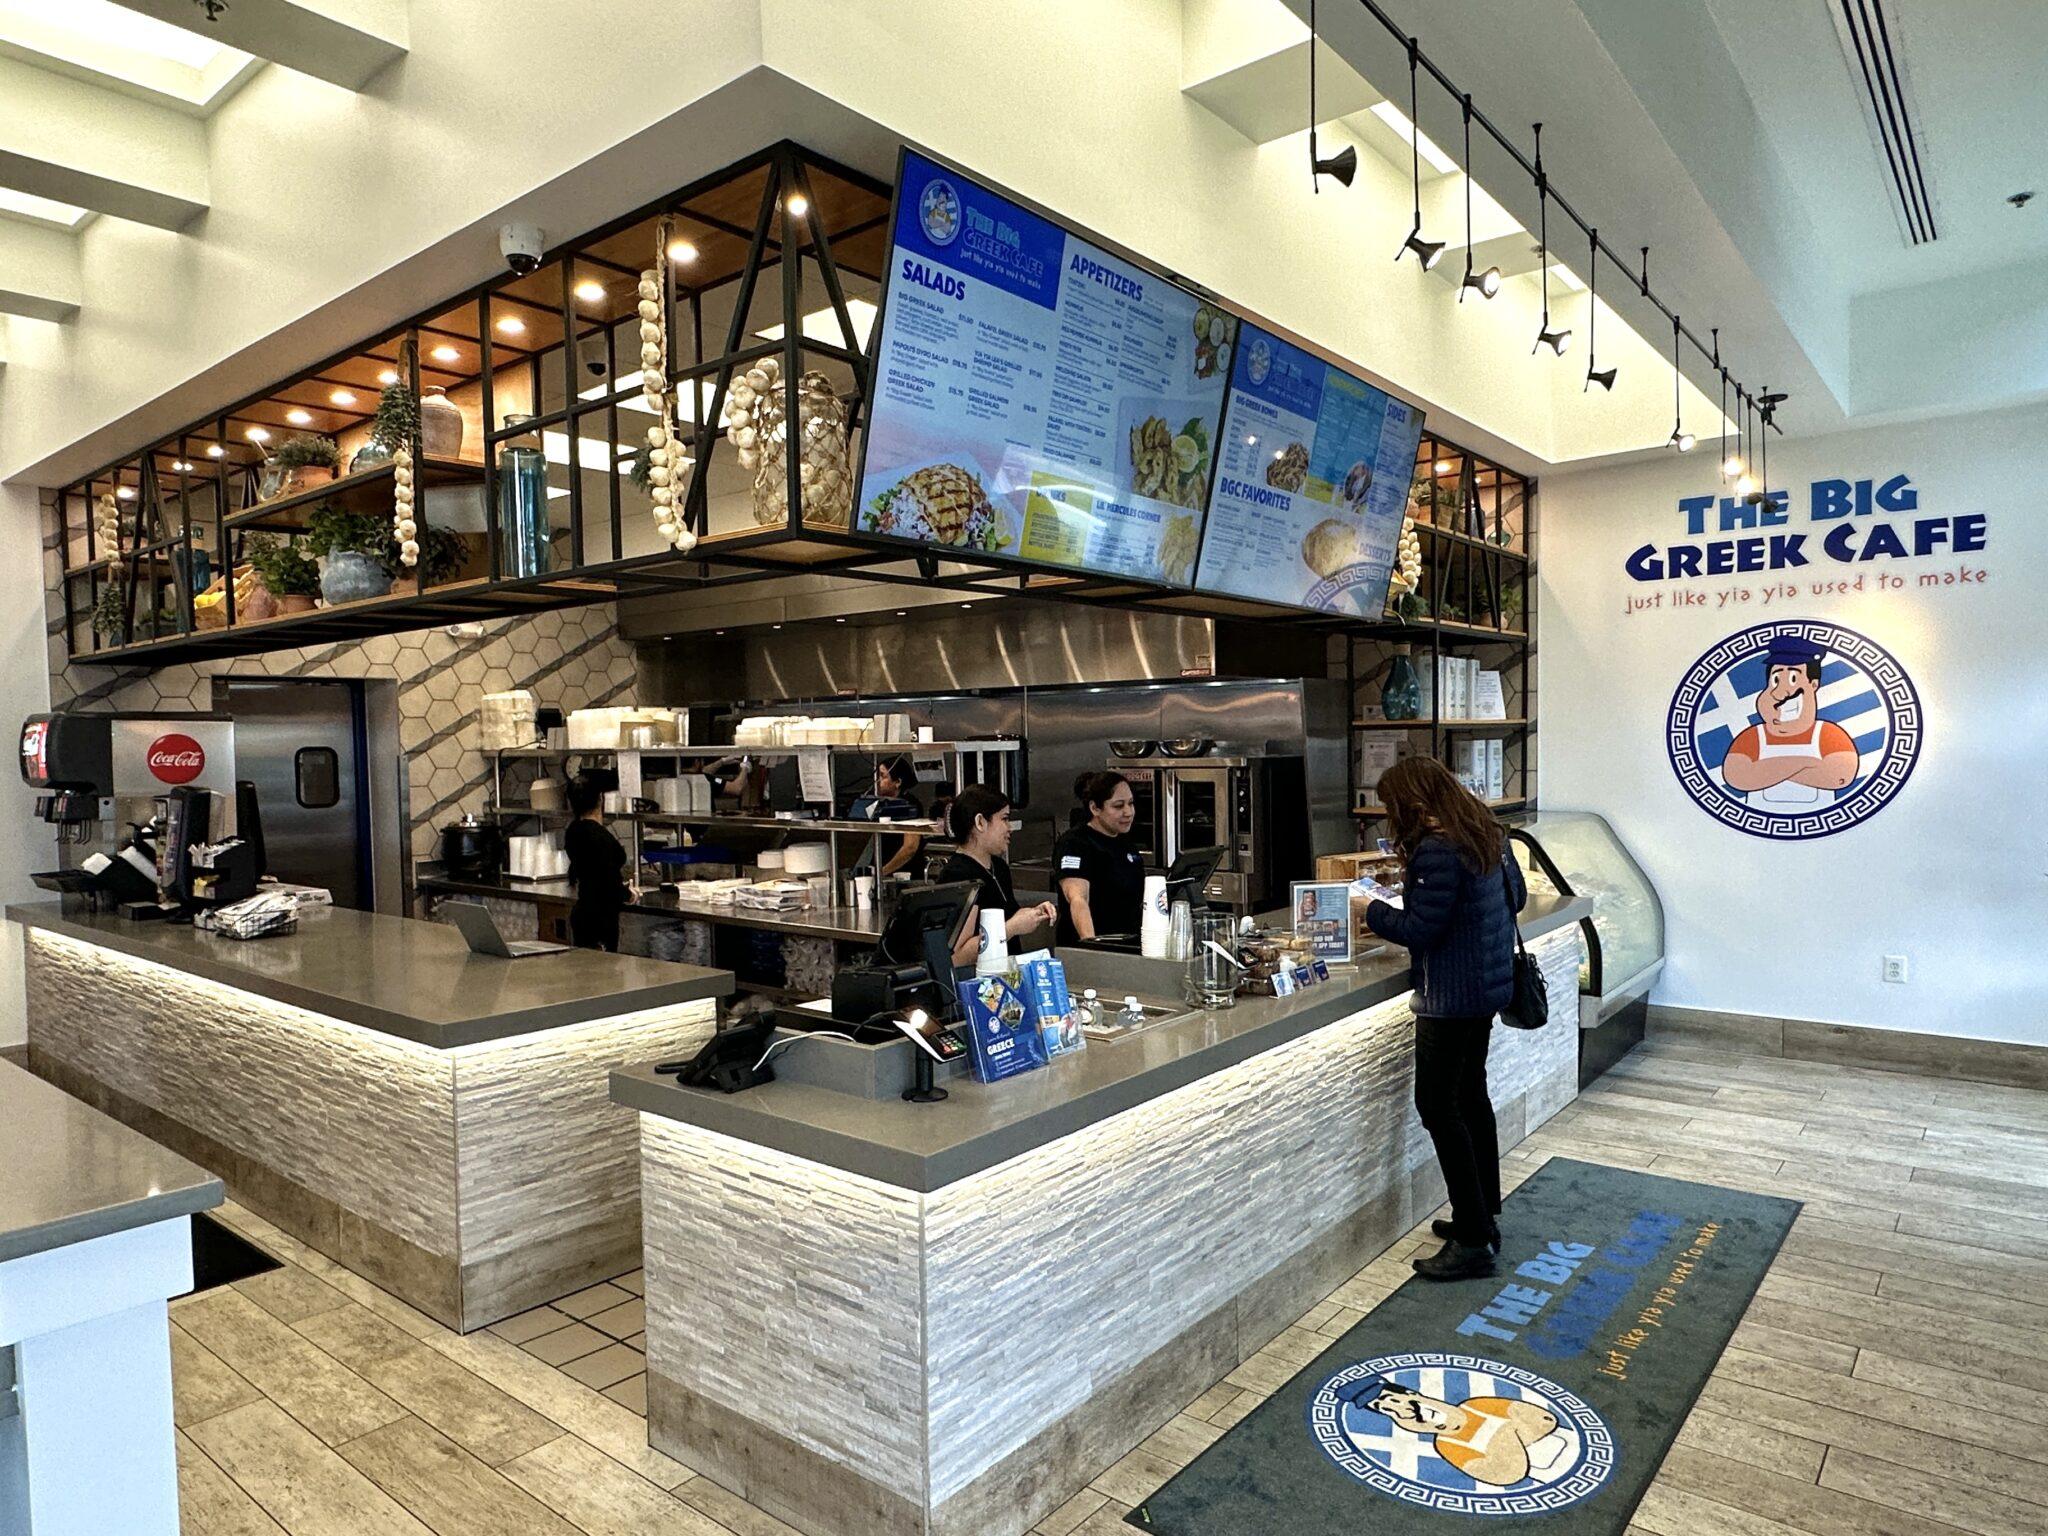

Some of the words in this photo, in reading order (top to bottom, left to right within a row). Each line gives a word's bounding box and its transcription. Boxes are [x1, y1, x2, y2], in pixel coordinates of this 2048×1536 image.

[962, 227, 1010, 262] GREEK
[1010, 249, 1043, 277] CAFE
[1070, 253, 1143, 301] APPETIZERS
[902, 259, 965, 300] SALADS
[1107, 502, 1136, 516] HERCULES
[1137, 510, 1160, 522] CORNER
[1220, 477, 1241, 496] BGC
[1241, 484, 1290, 510] FAVORITES
[1679, 490, 1789, 534] THE
[1811, 474, 1918, 521] BIG
[1625, 534, 1809, 582] GREEK
[1823, 514, 1987, 563] CAFE
[1625, 594, 1663, 615] just
[1672, 591, 1706, 608] like
[1718, 588, 1750, 609] yia
[1763, 584, 1797, 605] yia
[1812, 575, 1864, 595] used
[1879, 572, 1903, 589] to
[1919, 565, 1988, 587] make
[987, 1038, 1015, 1056] GREECE
[1455, 1283, 1553, 1342] THE
[1515, 1241, 1596, 1285] BIG
[1597, 1350, 1631, 1382] just
[1618, 1328, 1650, 1353] like
[1670, 1259, 1696, 1286] used
[1695, 1220, 1723, 1249] make
